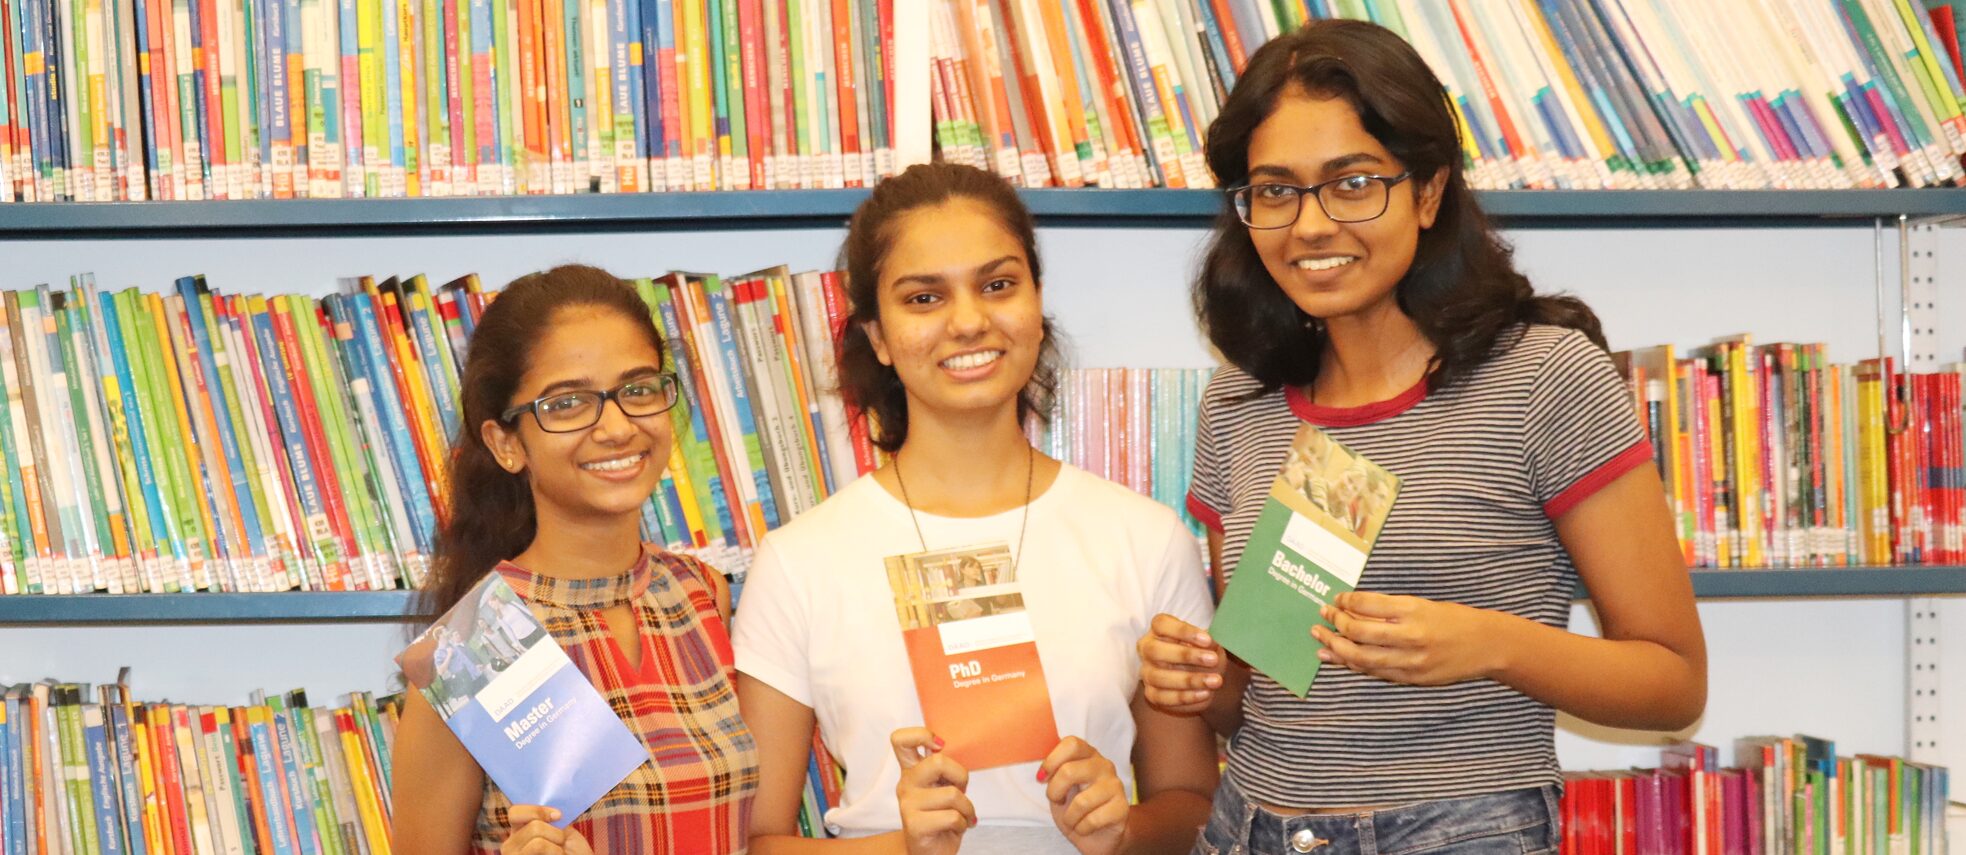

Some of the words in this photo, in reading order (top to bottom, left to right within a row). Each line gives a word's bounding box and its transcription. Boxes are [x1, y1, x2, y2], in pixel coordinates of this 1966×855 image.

[271, 3, 280, 36] Kursbuch
[272, 48, 283, 86] BLUME
[525, 52, 534, 97] MENSCHEN
[616, 43, 626, 80] BLUME
[746, 42, 756, 88] MENSCHEN
[840, 42, 850, 88] MENSCHEN
[1130, 41, 1148, 79] BLUME
[49, 73, 58, 100] studio
[617, 82, 628, 114] LAUE
[1142, 82, 1159, 116] BLAUE
[273, 90, 284, 127] BLAUE
[363, 318, 383, 356] Lagune
[416, 315, 436, 356] Lagune
[712, 301, 733, 343] Lagune
[262, 327, 277, 359] Ausgabe
[749, 326, 763, 362] Passwort
[766, 325, 780, 361] Passwort
[269, 360, 286, 394] Englische
[432, 362, 452, 411] Arbeitsbuch
[725, 348, 744, 398] Arbeitsbuch
[379, 364, 405, 430] Lehrerhandbuch
[281, 399, 296, 433] Kursbuch
[292, 442, 310, 481] BLUME
[773, 424, 792, 472] Übungsbuch
[787, 423, 807, 471] Übungsbuch
[303, 483, 318, 513] LAUE
[785, 475, 795, 491] und
[801, 473, 811, 489] und
[790, 493, 800, 514] Kurs-
[1268, 566, 1291, 585] Degree
[1289, 580, 1298, 590] in
[1272, 550, 1330, 596] Bachelor
[949, 660, 982, 680] PhD
[953, 678, 981, 688] Degree
[992, 671, 1025, 682] Germany
[494, 698, 514, 716] DAAD
[504, 696, 554, 742] Master
[516, 722, 540, 750] Degree
[538, 720, 549, 731] in
[546, 696, 577, 723] Germany
[94, 740, 106, 773] Ausgabe
[117, 734, 132, 774] Lagune
[254, 732, 272, 774] Lagune
[275, 722, 293, 763] Lagune
[213, 754, 225, 791] Passwort
[287, 769, 304, 810] Kursbuch
[98, 774, 111, 809] Englische
[125, 781, 138, 822] Kursbuch
[265, 779, 286, 847] Lehrerhandbuch
[104, 814, 116, 850] Kursbuch
